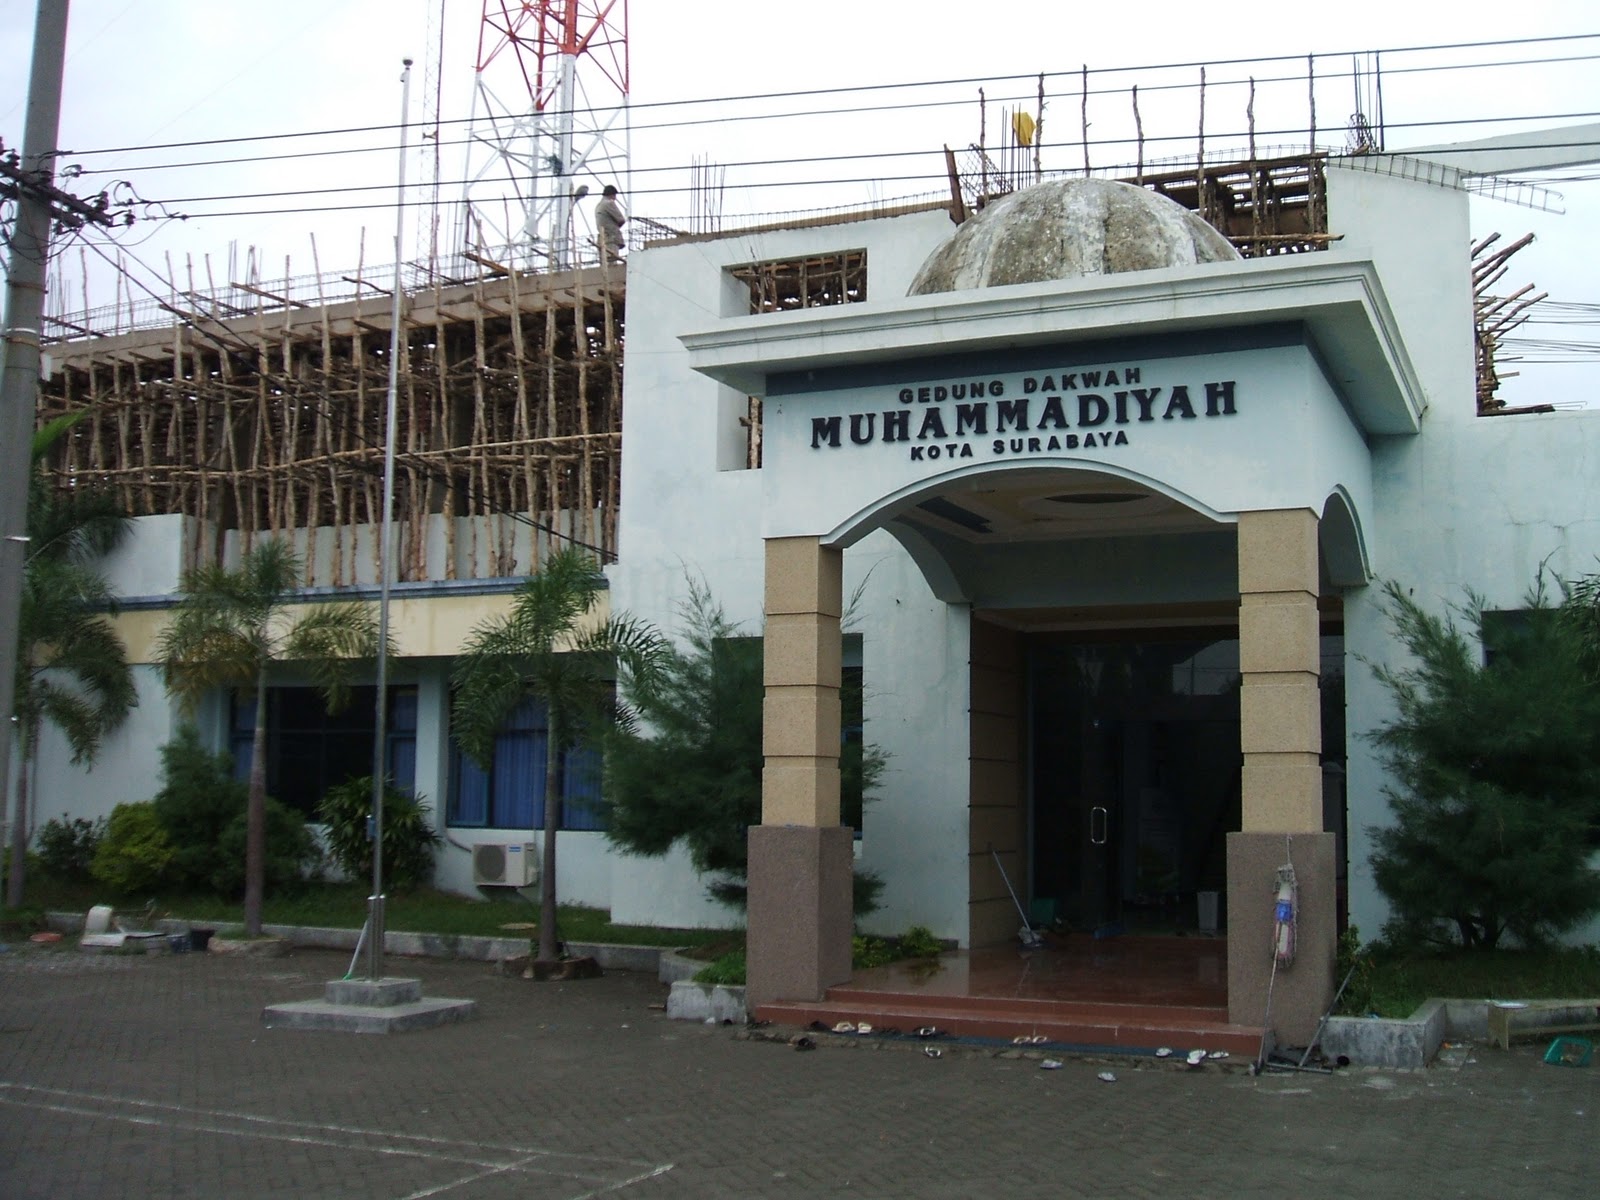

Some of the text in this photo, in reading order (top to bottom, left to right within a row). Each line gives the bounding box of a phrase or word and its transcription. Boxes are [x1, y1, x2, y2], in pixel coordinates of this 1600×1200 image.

[899, 367, 1142, 404] GEDUNG DAKWAH
[810, 381, 1238, 448] MUHAMMADIYAH
[910, 430, 1129, 461] KOTA SURABAYA
